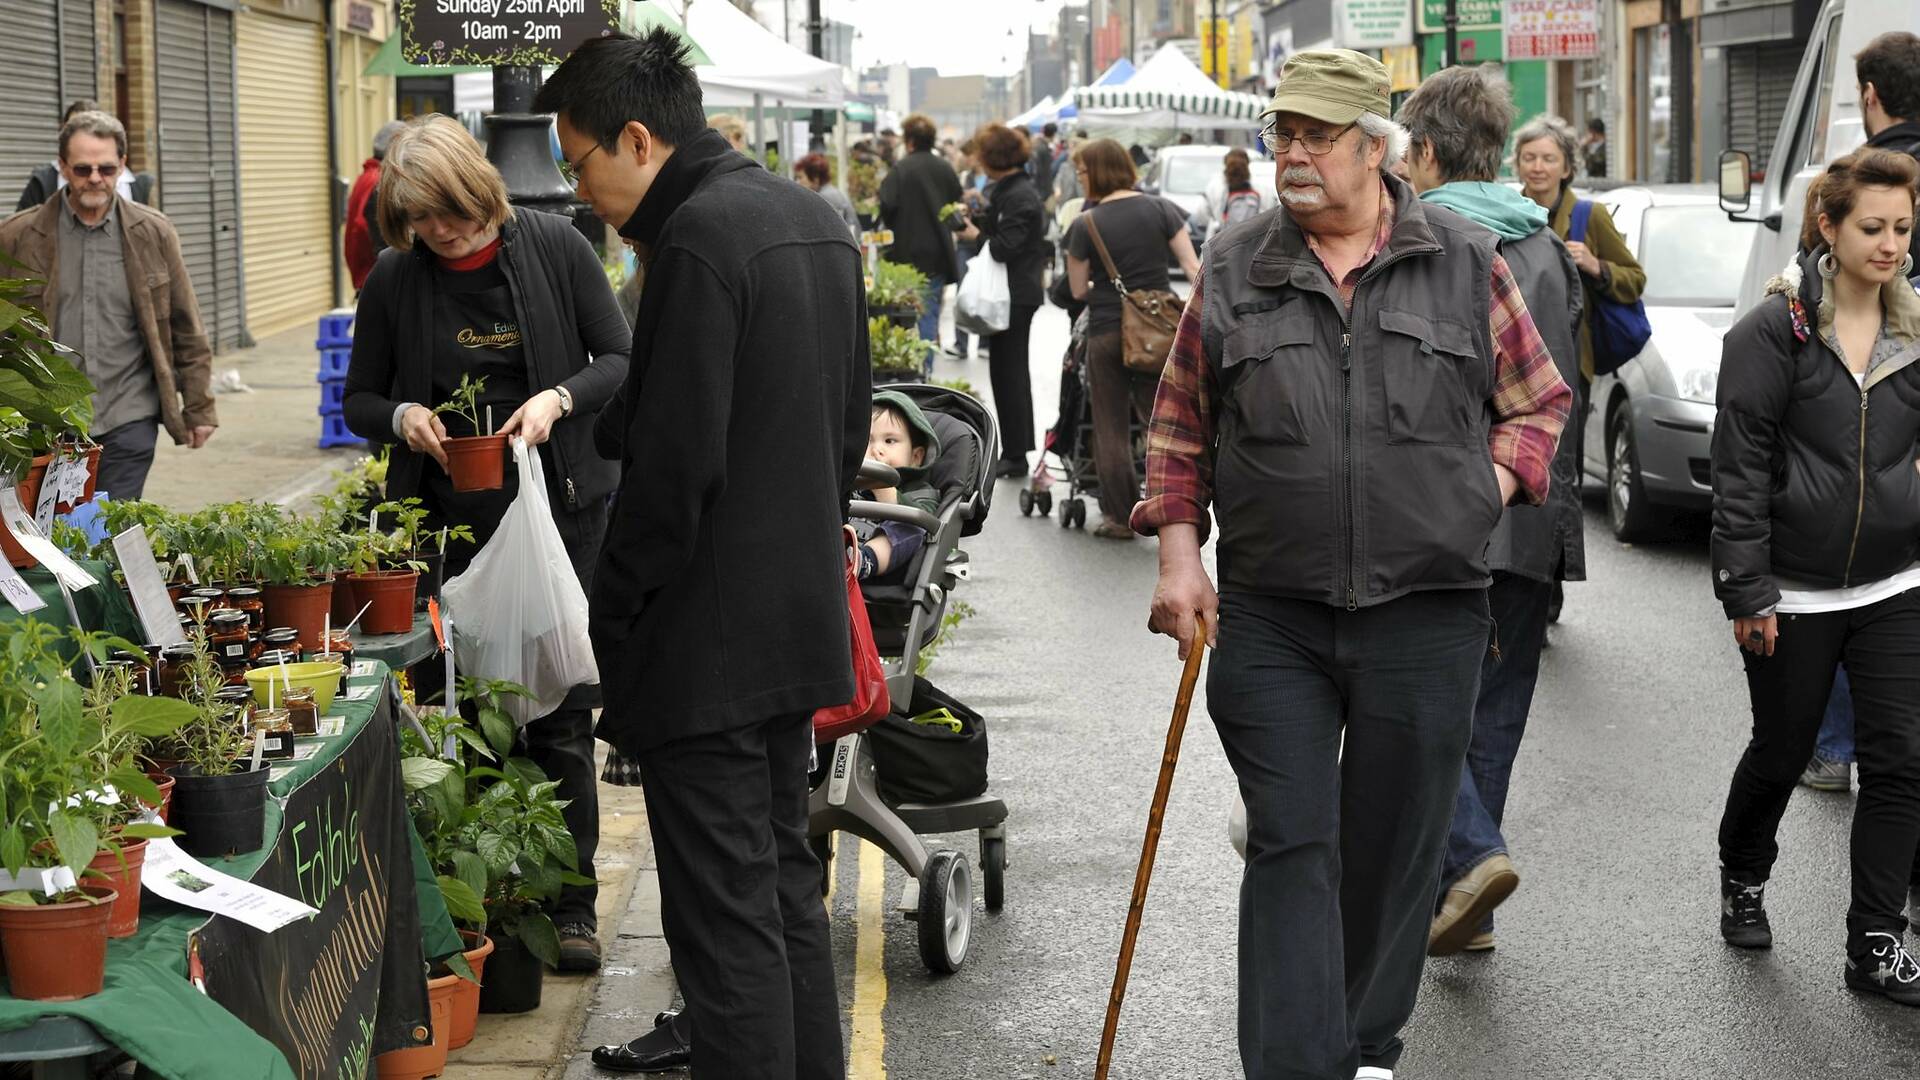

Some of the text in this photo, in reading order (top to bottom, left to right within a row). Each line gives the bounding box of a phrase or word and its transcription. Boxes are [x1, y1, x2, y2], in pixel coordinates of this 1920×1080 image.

[436, 0, 585, 18] Sunday 25th April
[1426, 1, 1502, 15] VETARIAN
[461, 20, 508, 40] 10am
[524, 20, 562, 44] 2pm
[457, 328, 521, 343] Ornament
[494, 321, 517, 334] Edib
[834, 745, 850, 779] STOKKE
[292, 780, 358, 922] Edible
